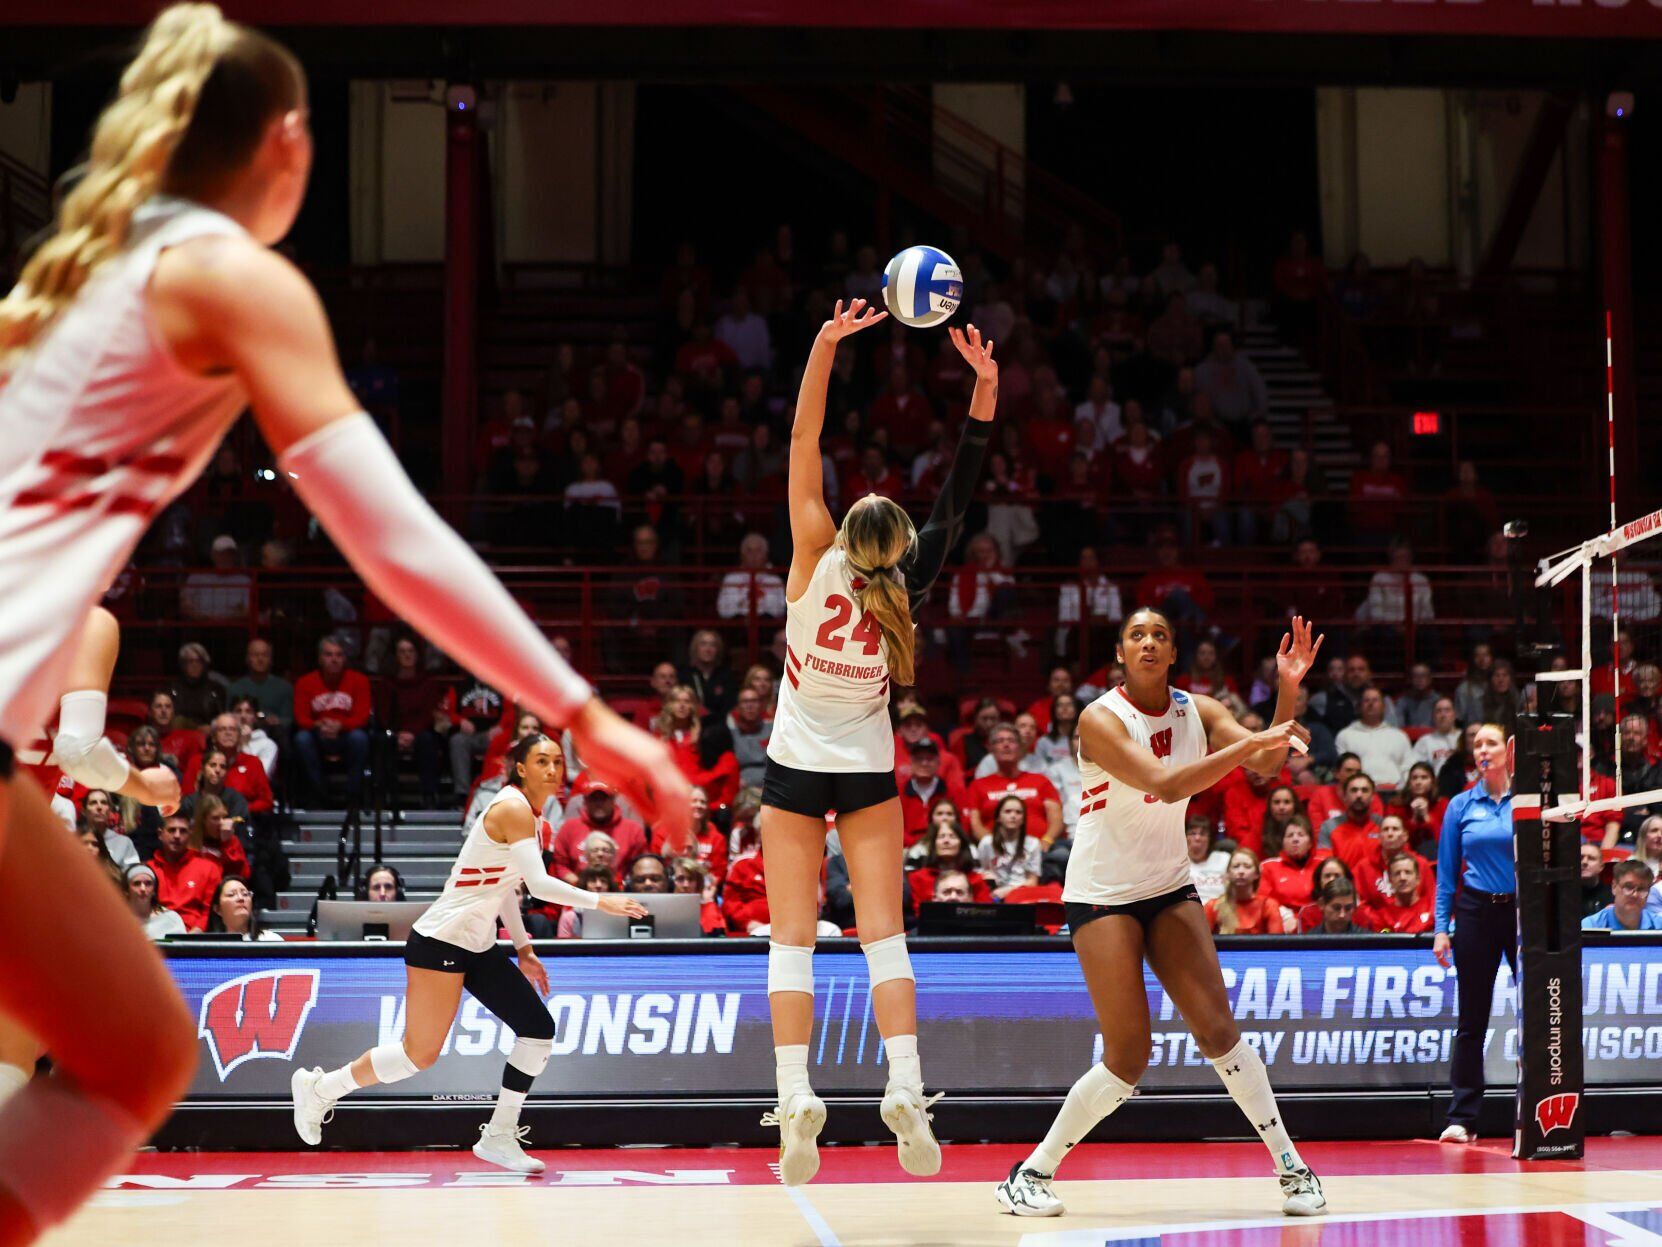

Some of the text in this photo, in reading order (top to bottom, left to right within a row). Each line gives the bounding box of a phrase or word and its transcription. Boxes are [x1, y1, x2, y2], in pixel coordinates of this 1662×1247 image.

[815, 593, 882, 656] 24
[804, 652, 884, 680] FUERBRINGER
[1149, 727, 1173, 759] W
[1159, 967, 1303, 1020] AA
[198, 968, 321, 1083] W
[378, 993, 741, 1056] SONSIN
[1091, 1031, 1212, 1067] STE
[1291, 1028, 1496, 1065] UNIVERSI
[1582, 1026, 1662, 1061] ISCO
[1546, 977, 1564, 1086] sports imports
[1534, 1092, 1580, 1139] W
